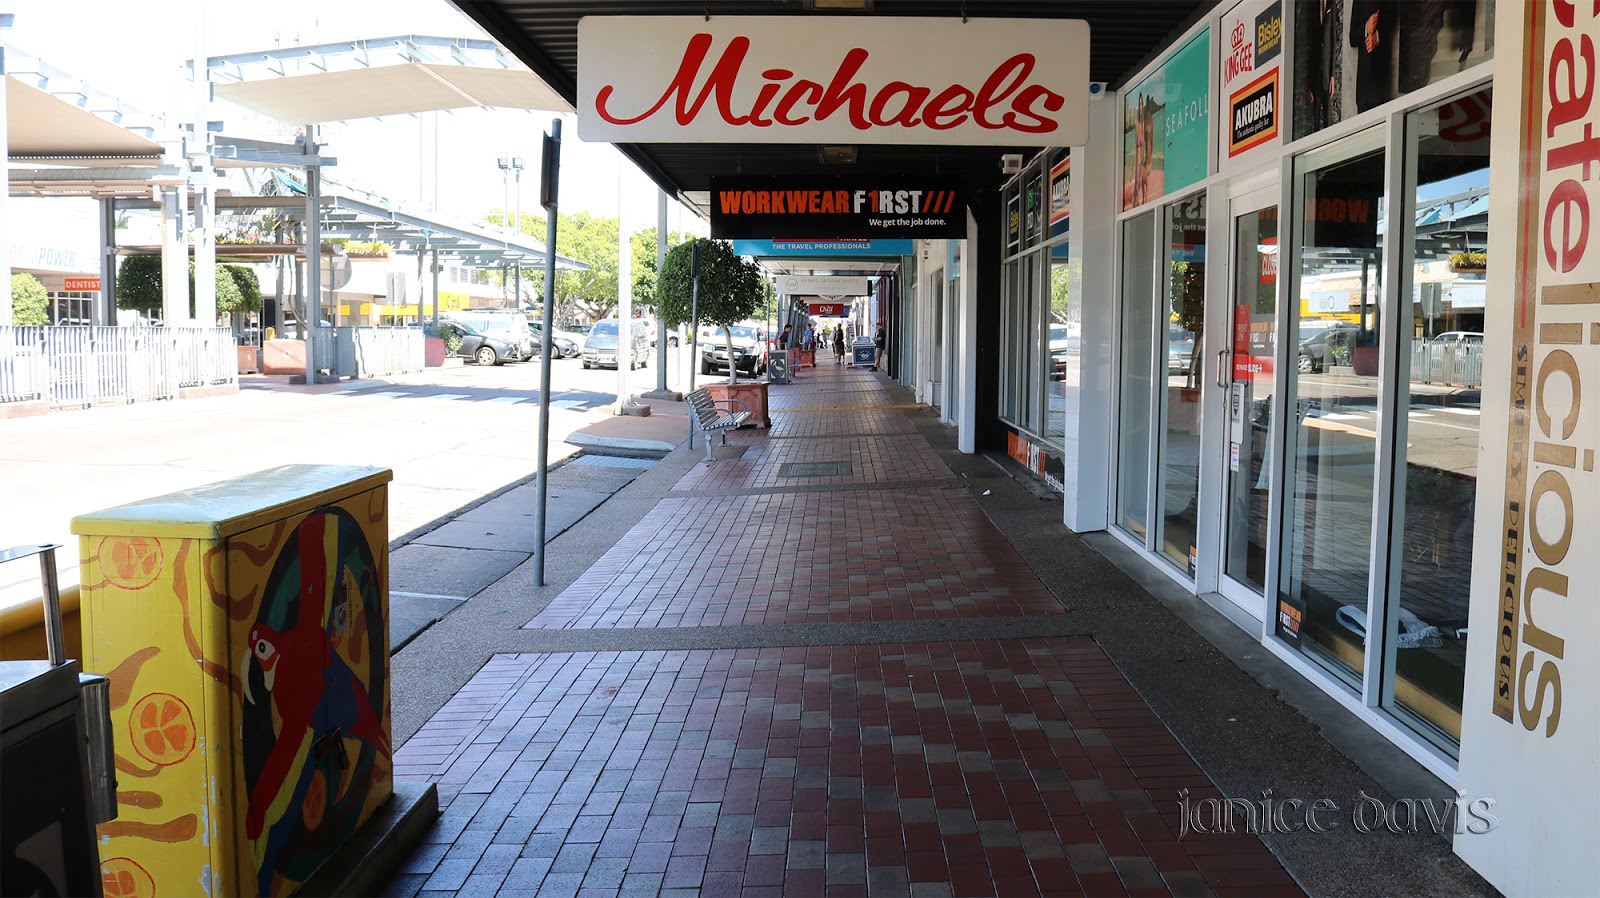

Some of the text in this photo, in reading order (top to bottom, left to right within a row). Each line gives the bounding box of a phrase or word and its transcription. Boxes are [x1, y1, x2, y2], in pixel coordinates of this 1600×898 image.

[1258, 16, 1282, 46] Bisley
[1258, 37, 1279, 55] WORKWEAR
[594, 33, 1065, 134] Michaels
[1235, 92, 1273, 130] AKUBRA
[719, 190, 850, 214] WORKWEAR
[869, 217, 946, 228] We get the job done.
[1498, 344, 1528, 701] SIMPLY DELICIOUS
